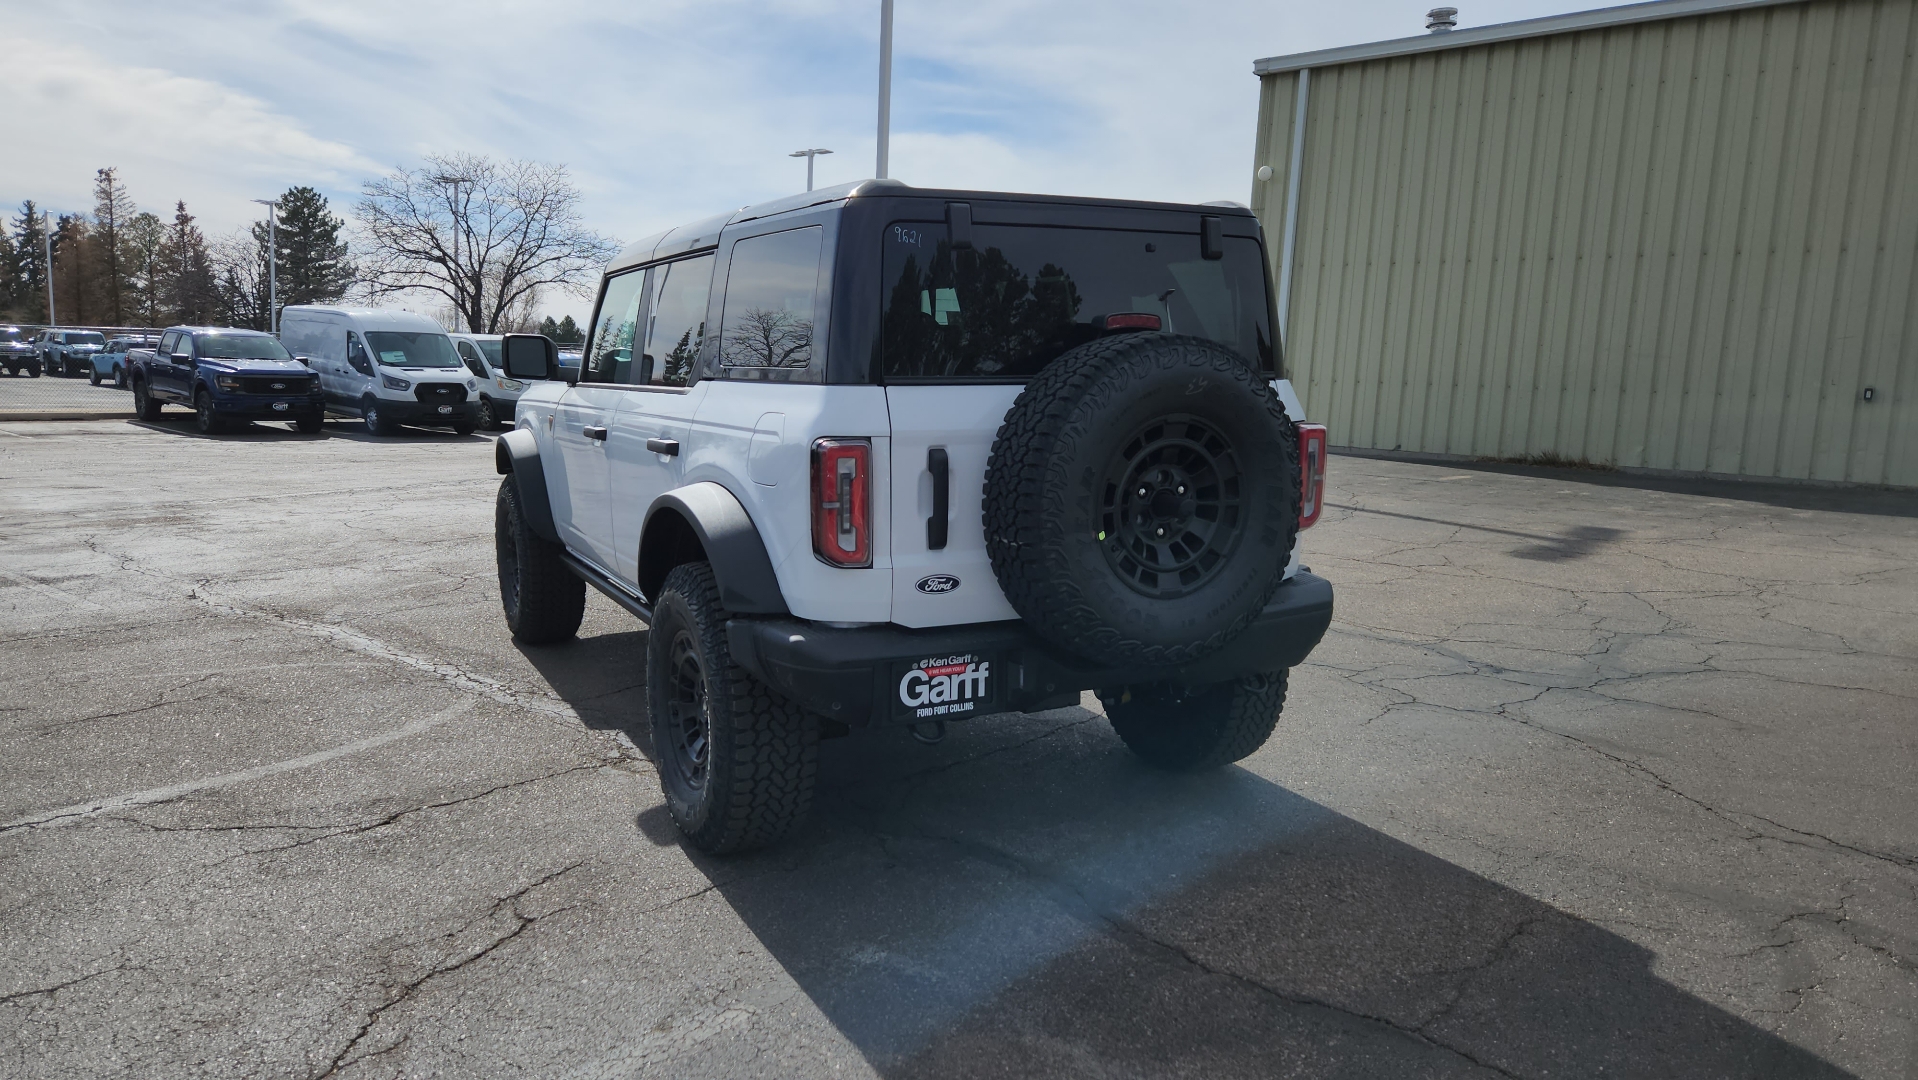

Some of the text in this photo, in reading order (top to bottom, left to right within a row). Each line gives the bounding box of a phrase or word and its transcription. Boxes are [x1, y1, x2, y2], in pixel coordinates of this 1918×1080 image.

[894, 226, 922, 248] 9621
[924, 577, 953, 592] Ford
[929, 654, 972, 667] Ken Garff
[899, 661, 989, 707] Garff
[916, 701, 974, 718] FORD FORT COLLINS
